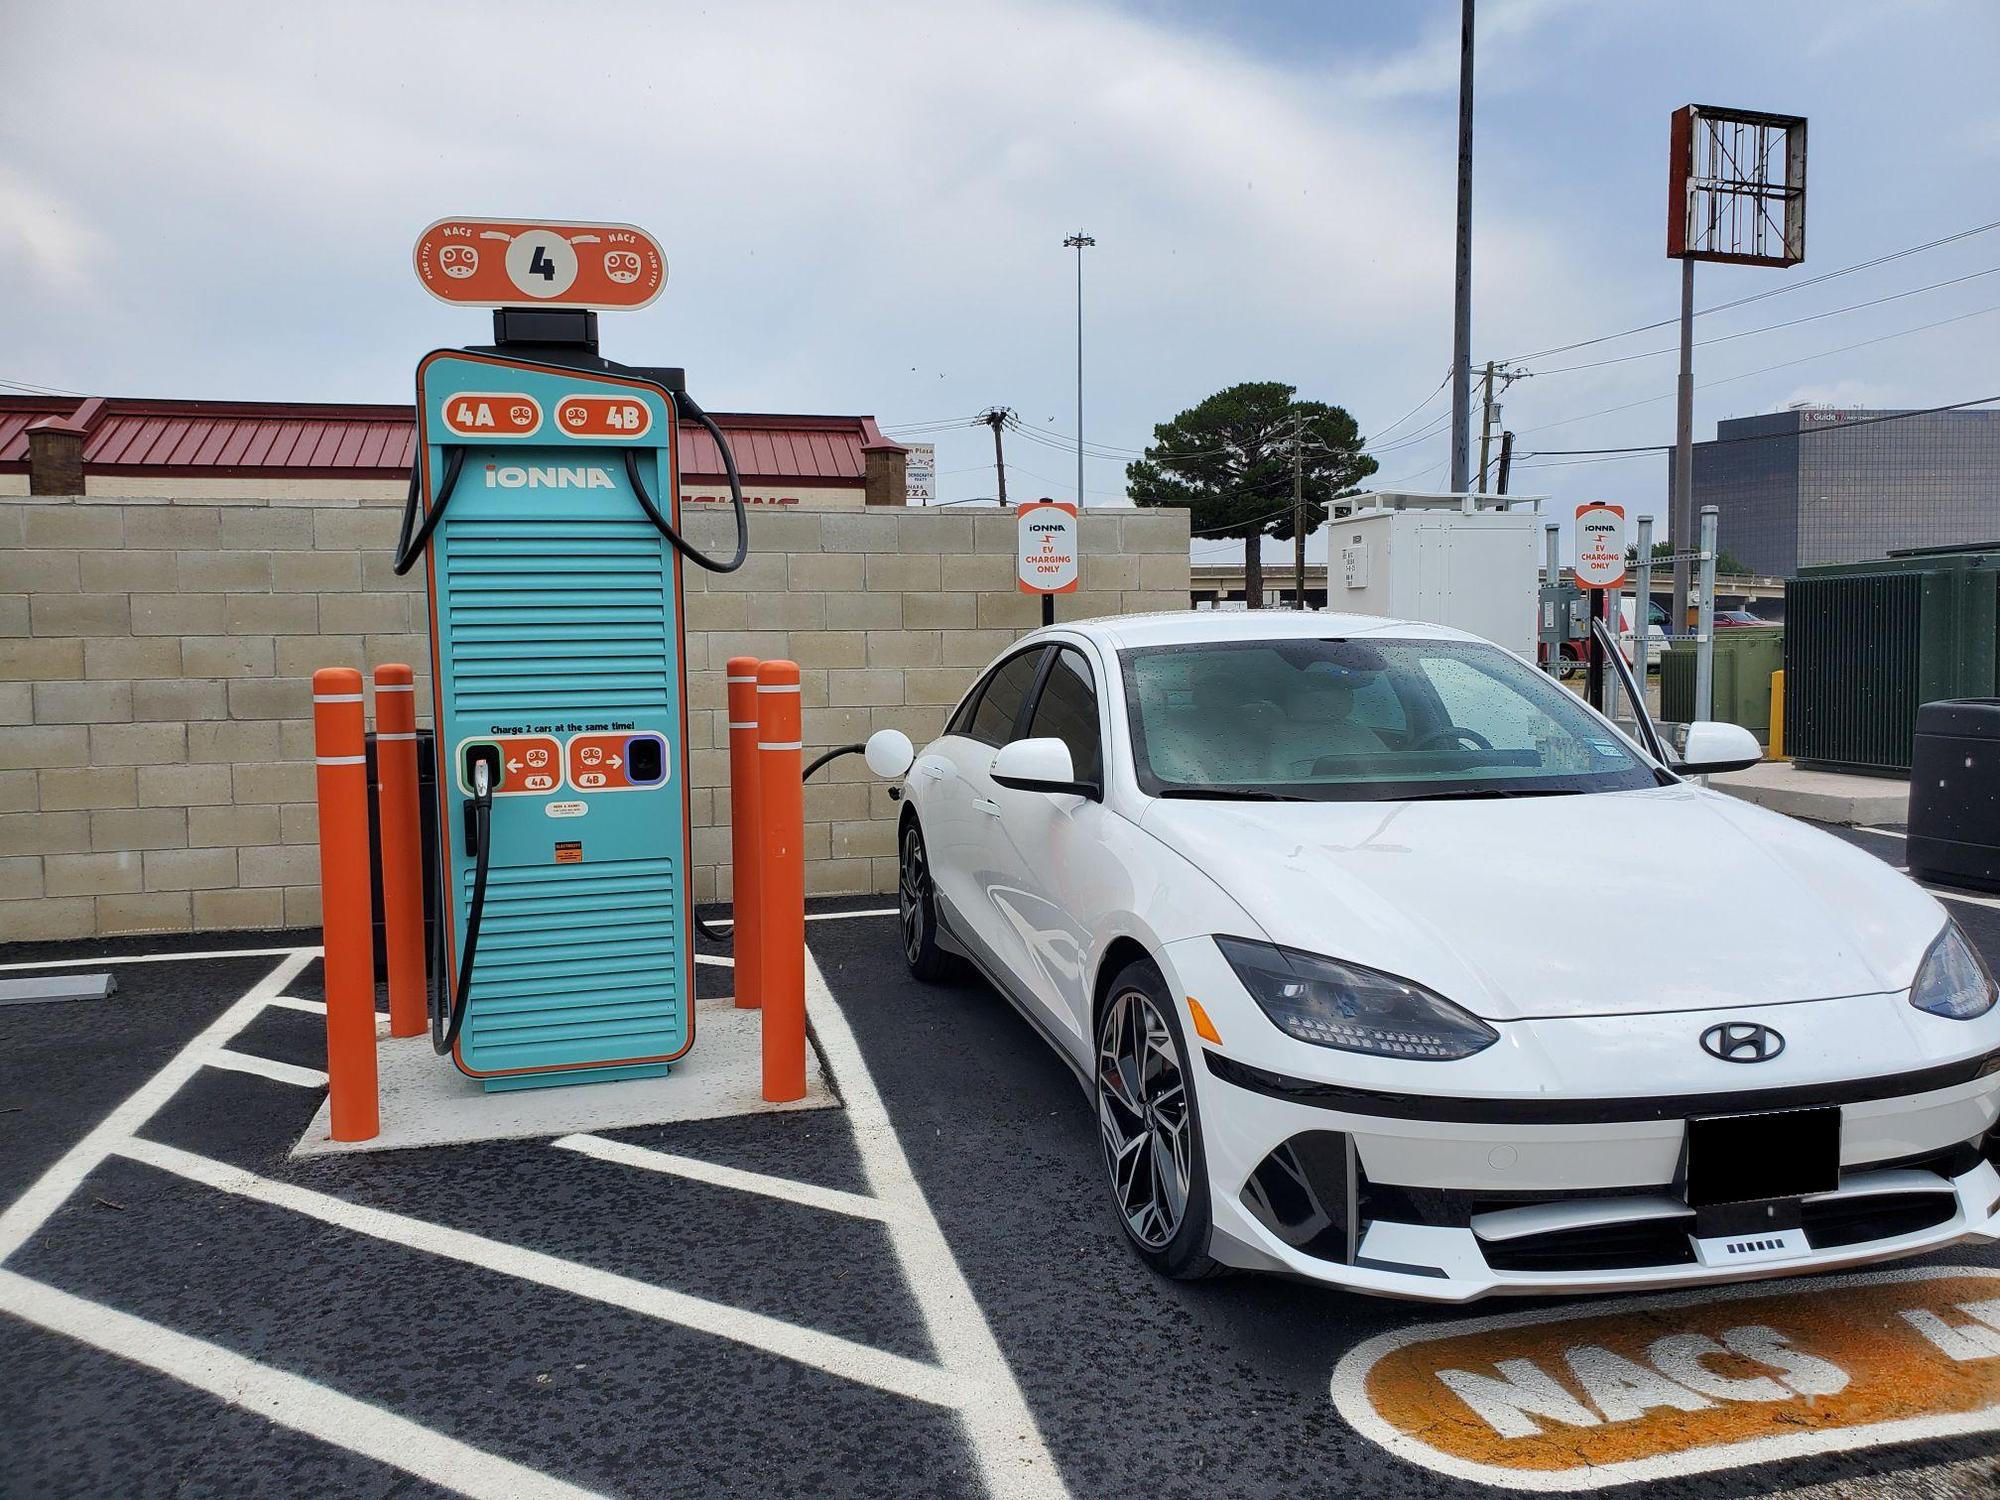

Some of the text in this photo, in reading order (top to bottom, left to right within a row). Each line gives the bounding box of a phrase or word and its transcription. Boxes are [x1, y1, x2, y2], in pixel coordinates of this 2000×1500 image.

[443, 226, 472, 237] NACS
[608, 233, 636, 244] NACS
[529, 246, 555, 281] 4
[456, 403, 495, 427] 4A
[606, 406, 640, 430] 4B
[1042, 546, 1054, 554] EV
[1025, 555, 1071, 564] CHARGING
[1581, 553, 1619, 561] CHARGING
[1037, 565, 1060, 573] ONLY
[1590, 562, 1610, 570] ONLY
[491, 721, 635, 735] Charge 2 cars at the same time!
[531, 777, 546, 787] 4A
[586, 775, 600, 785] 4B
[1433, 1323, 1852, 1440] NACS
